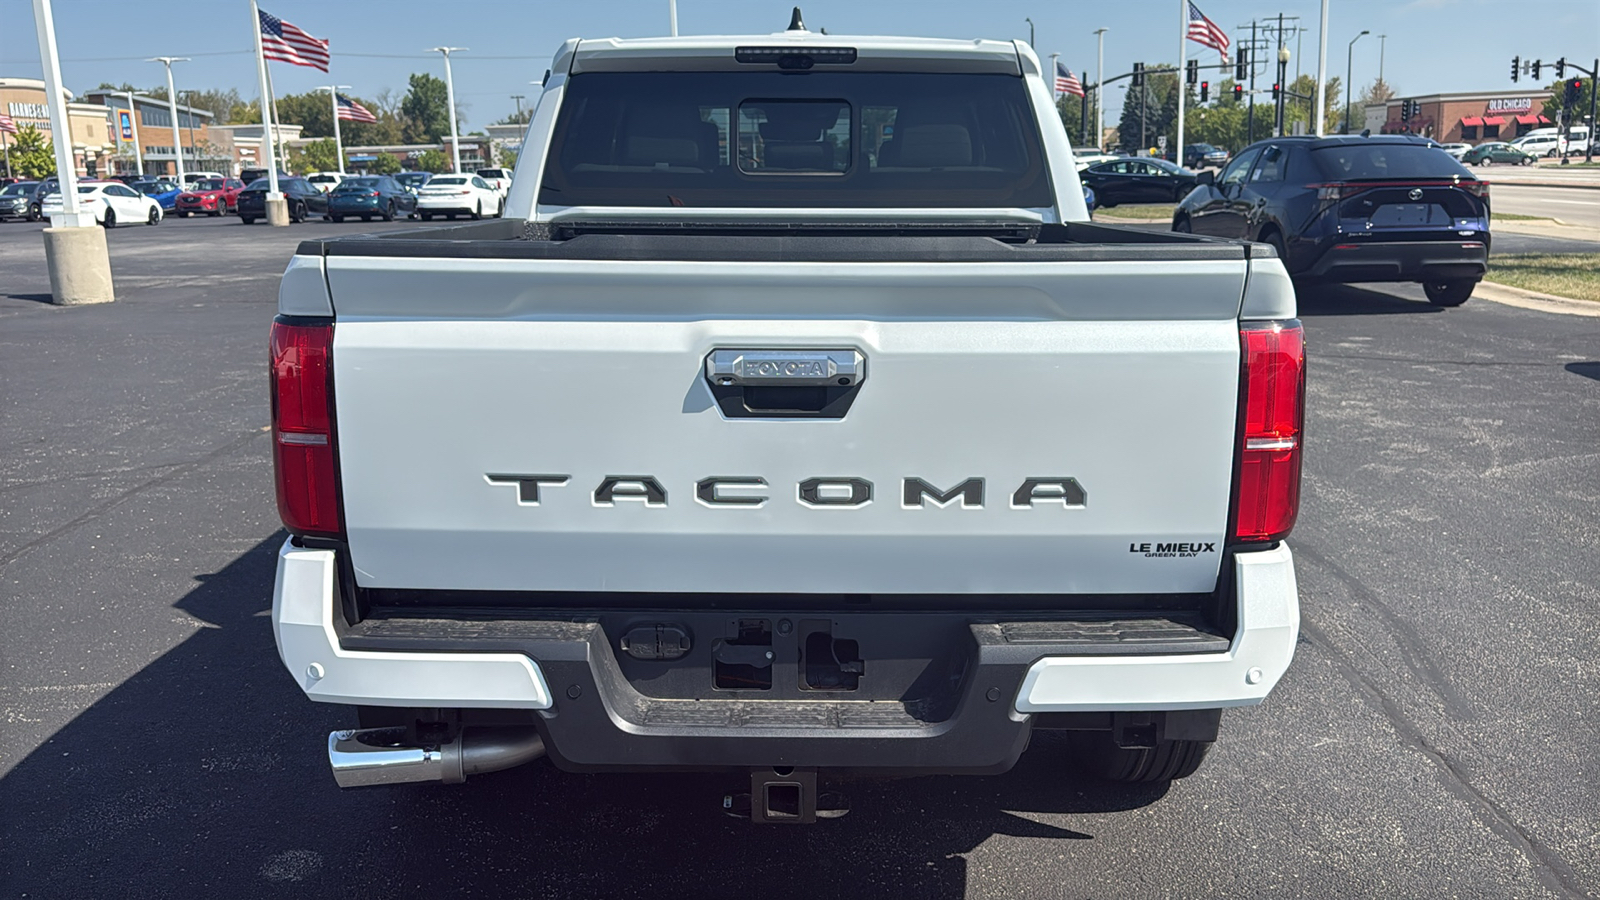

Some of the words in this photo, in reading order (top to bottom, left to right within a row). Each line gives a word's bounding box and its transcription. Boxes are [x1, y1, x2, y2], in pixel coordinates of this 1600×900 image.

[1489, 99, 1502, 110] OLD
[1503, 98, 1531, 109] CHICAGO
[746, 361, 824, 376] TOYOTA
[485, 473, 1088, 510] TACOMA
[1129, 543, 1152, 552] LE
[1156, 543, 1215, 552] MIEUX
